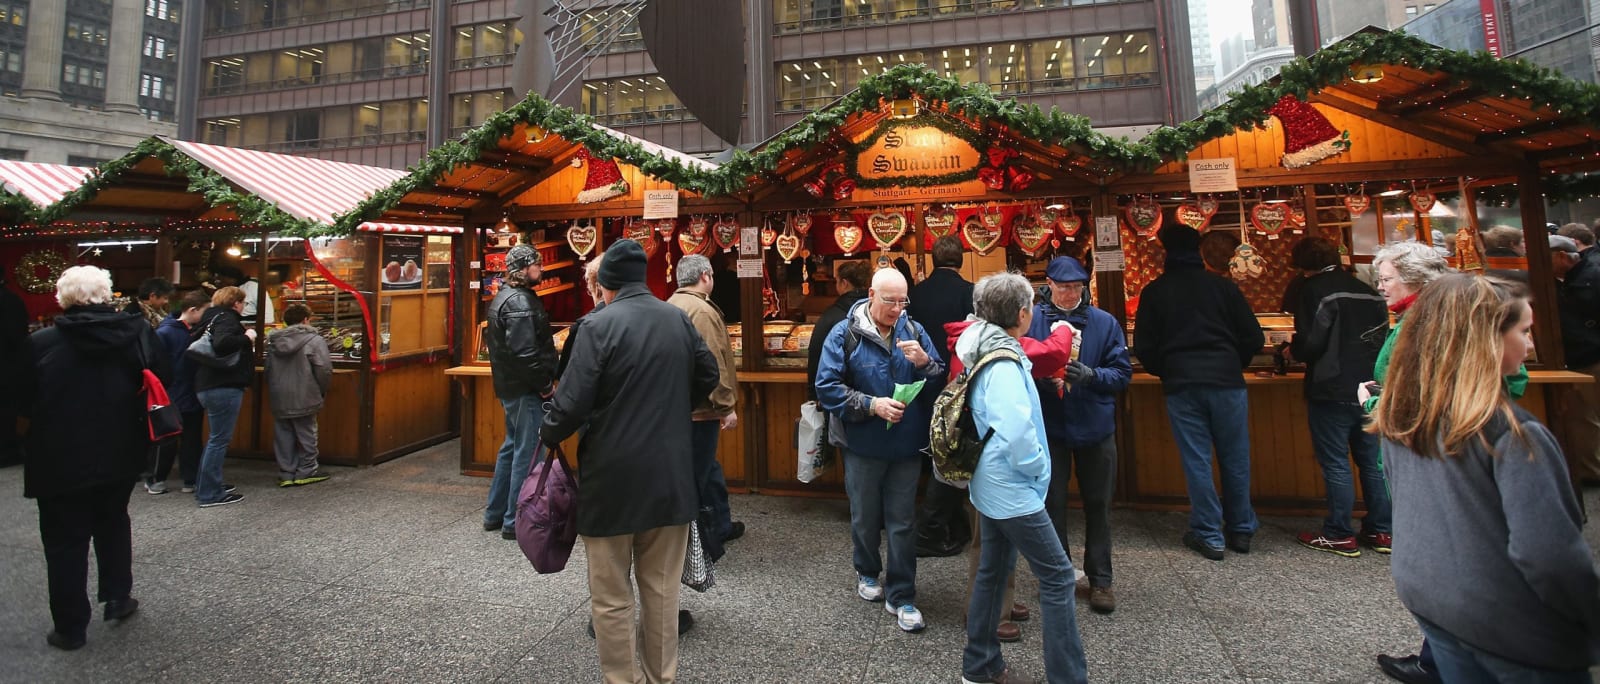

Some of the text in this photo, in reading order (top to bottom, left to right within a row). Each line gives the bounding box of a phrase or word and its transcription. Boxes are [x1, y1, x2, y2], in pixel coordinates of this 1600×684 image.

[1484, 13, 1496, 35] STATE
[872, 155, 961, 174] Swabian
[1195, 162, 1230, 170] Cash only
[648, 192, 661, 200] Cash
[873, 188, 912, 198] Stuttgart
[919, 186, 962, 195] Germany
